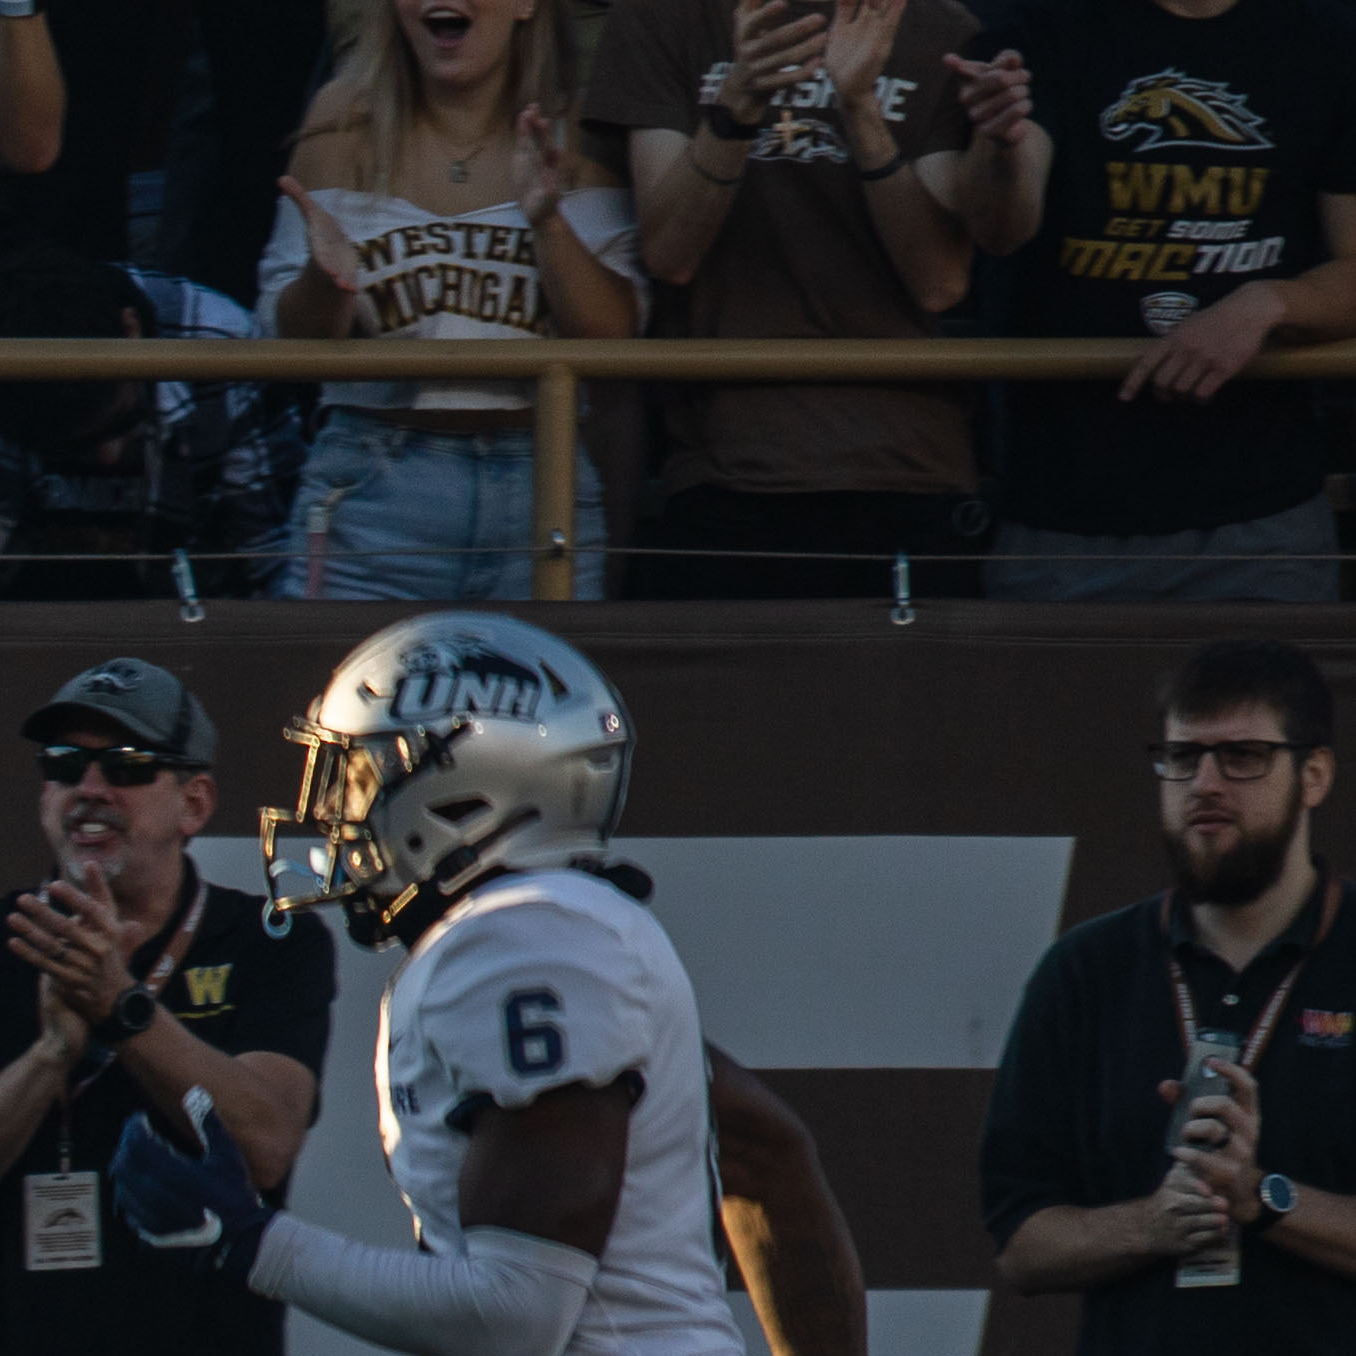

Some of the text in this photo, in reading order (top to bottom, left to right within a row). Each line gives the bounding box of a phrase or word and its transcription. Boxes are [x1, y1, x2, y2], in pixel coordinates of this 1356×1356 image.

[1104, 160, 1272, 217] WMU
[355, 222, 539, 271] WESTER
[1102, 216, 1255, 241] GET SOME
[389, 671, 542, 724] UNH
[183, 963, 234, 1006] W
[506, 986, 565, 1079] 6
